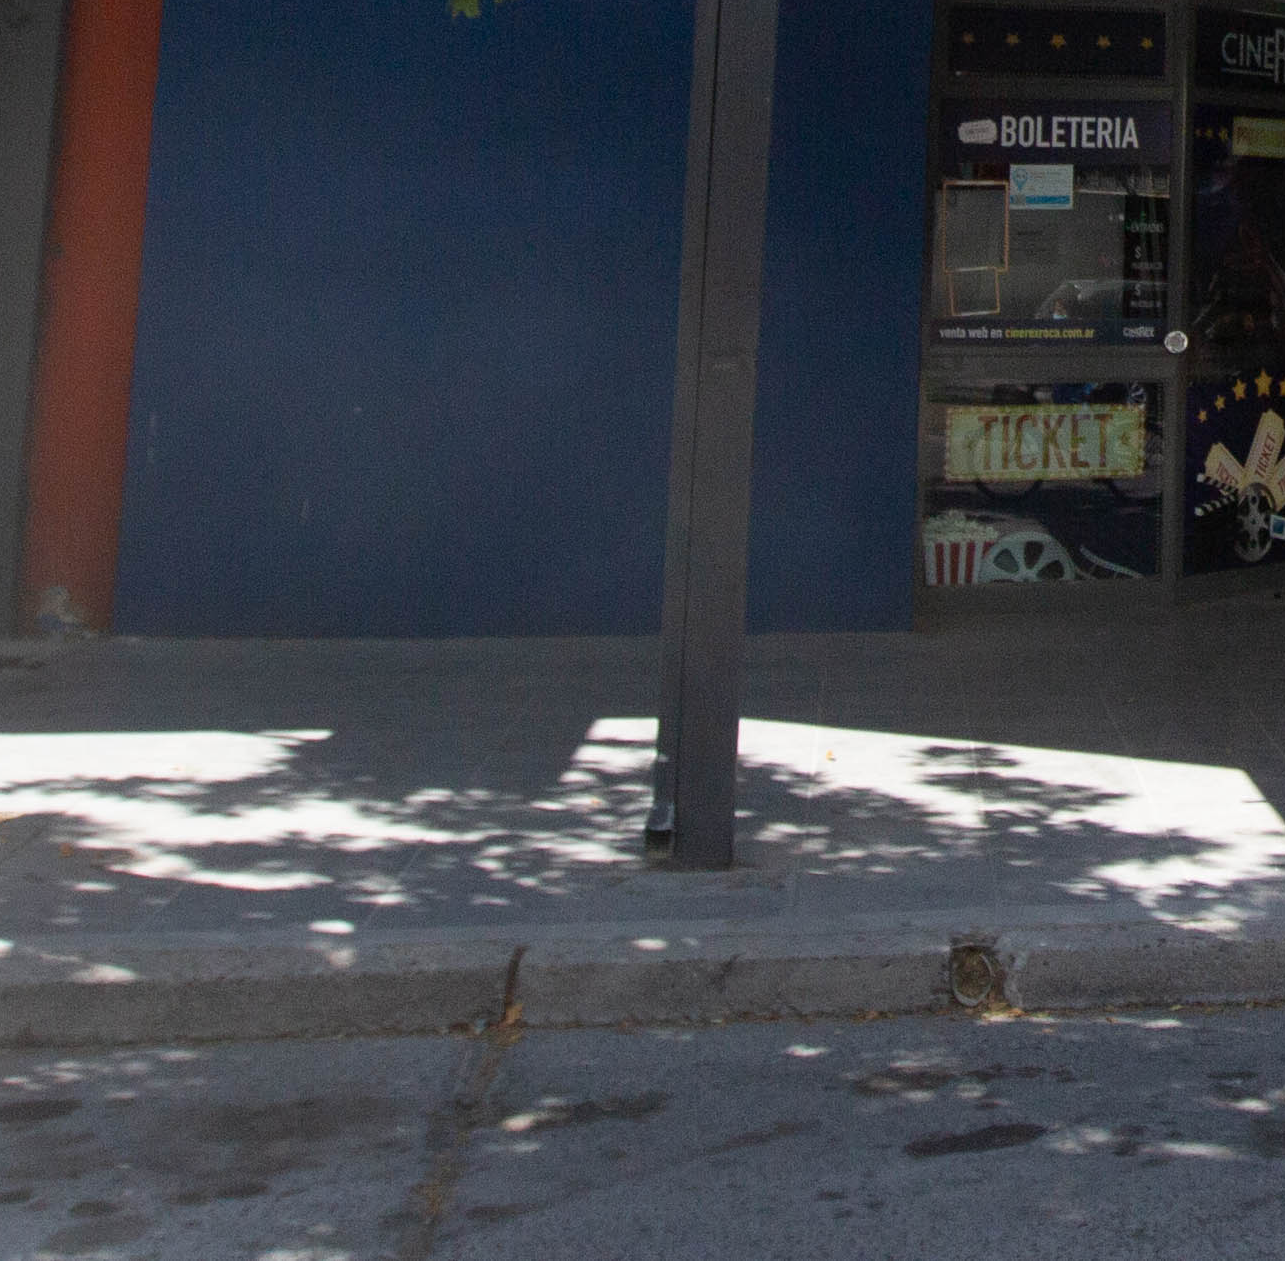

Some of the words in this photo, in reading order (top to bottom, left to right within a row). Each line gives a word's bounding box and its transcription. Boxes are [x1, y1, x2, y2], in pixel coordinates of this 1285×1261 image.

[1001, 115, 1140, 149] BOLETERIA
[978, 414, 1113, 470] TICKET
[1254, 431, 1277, 480] TICKET
